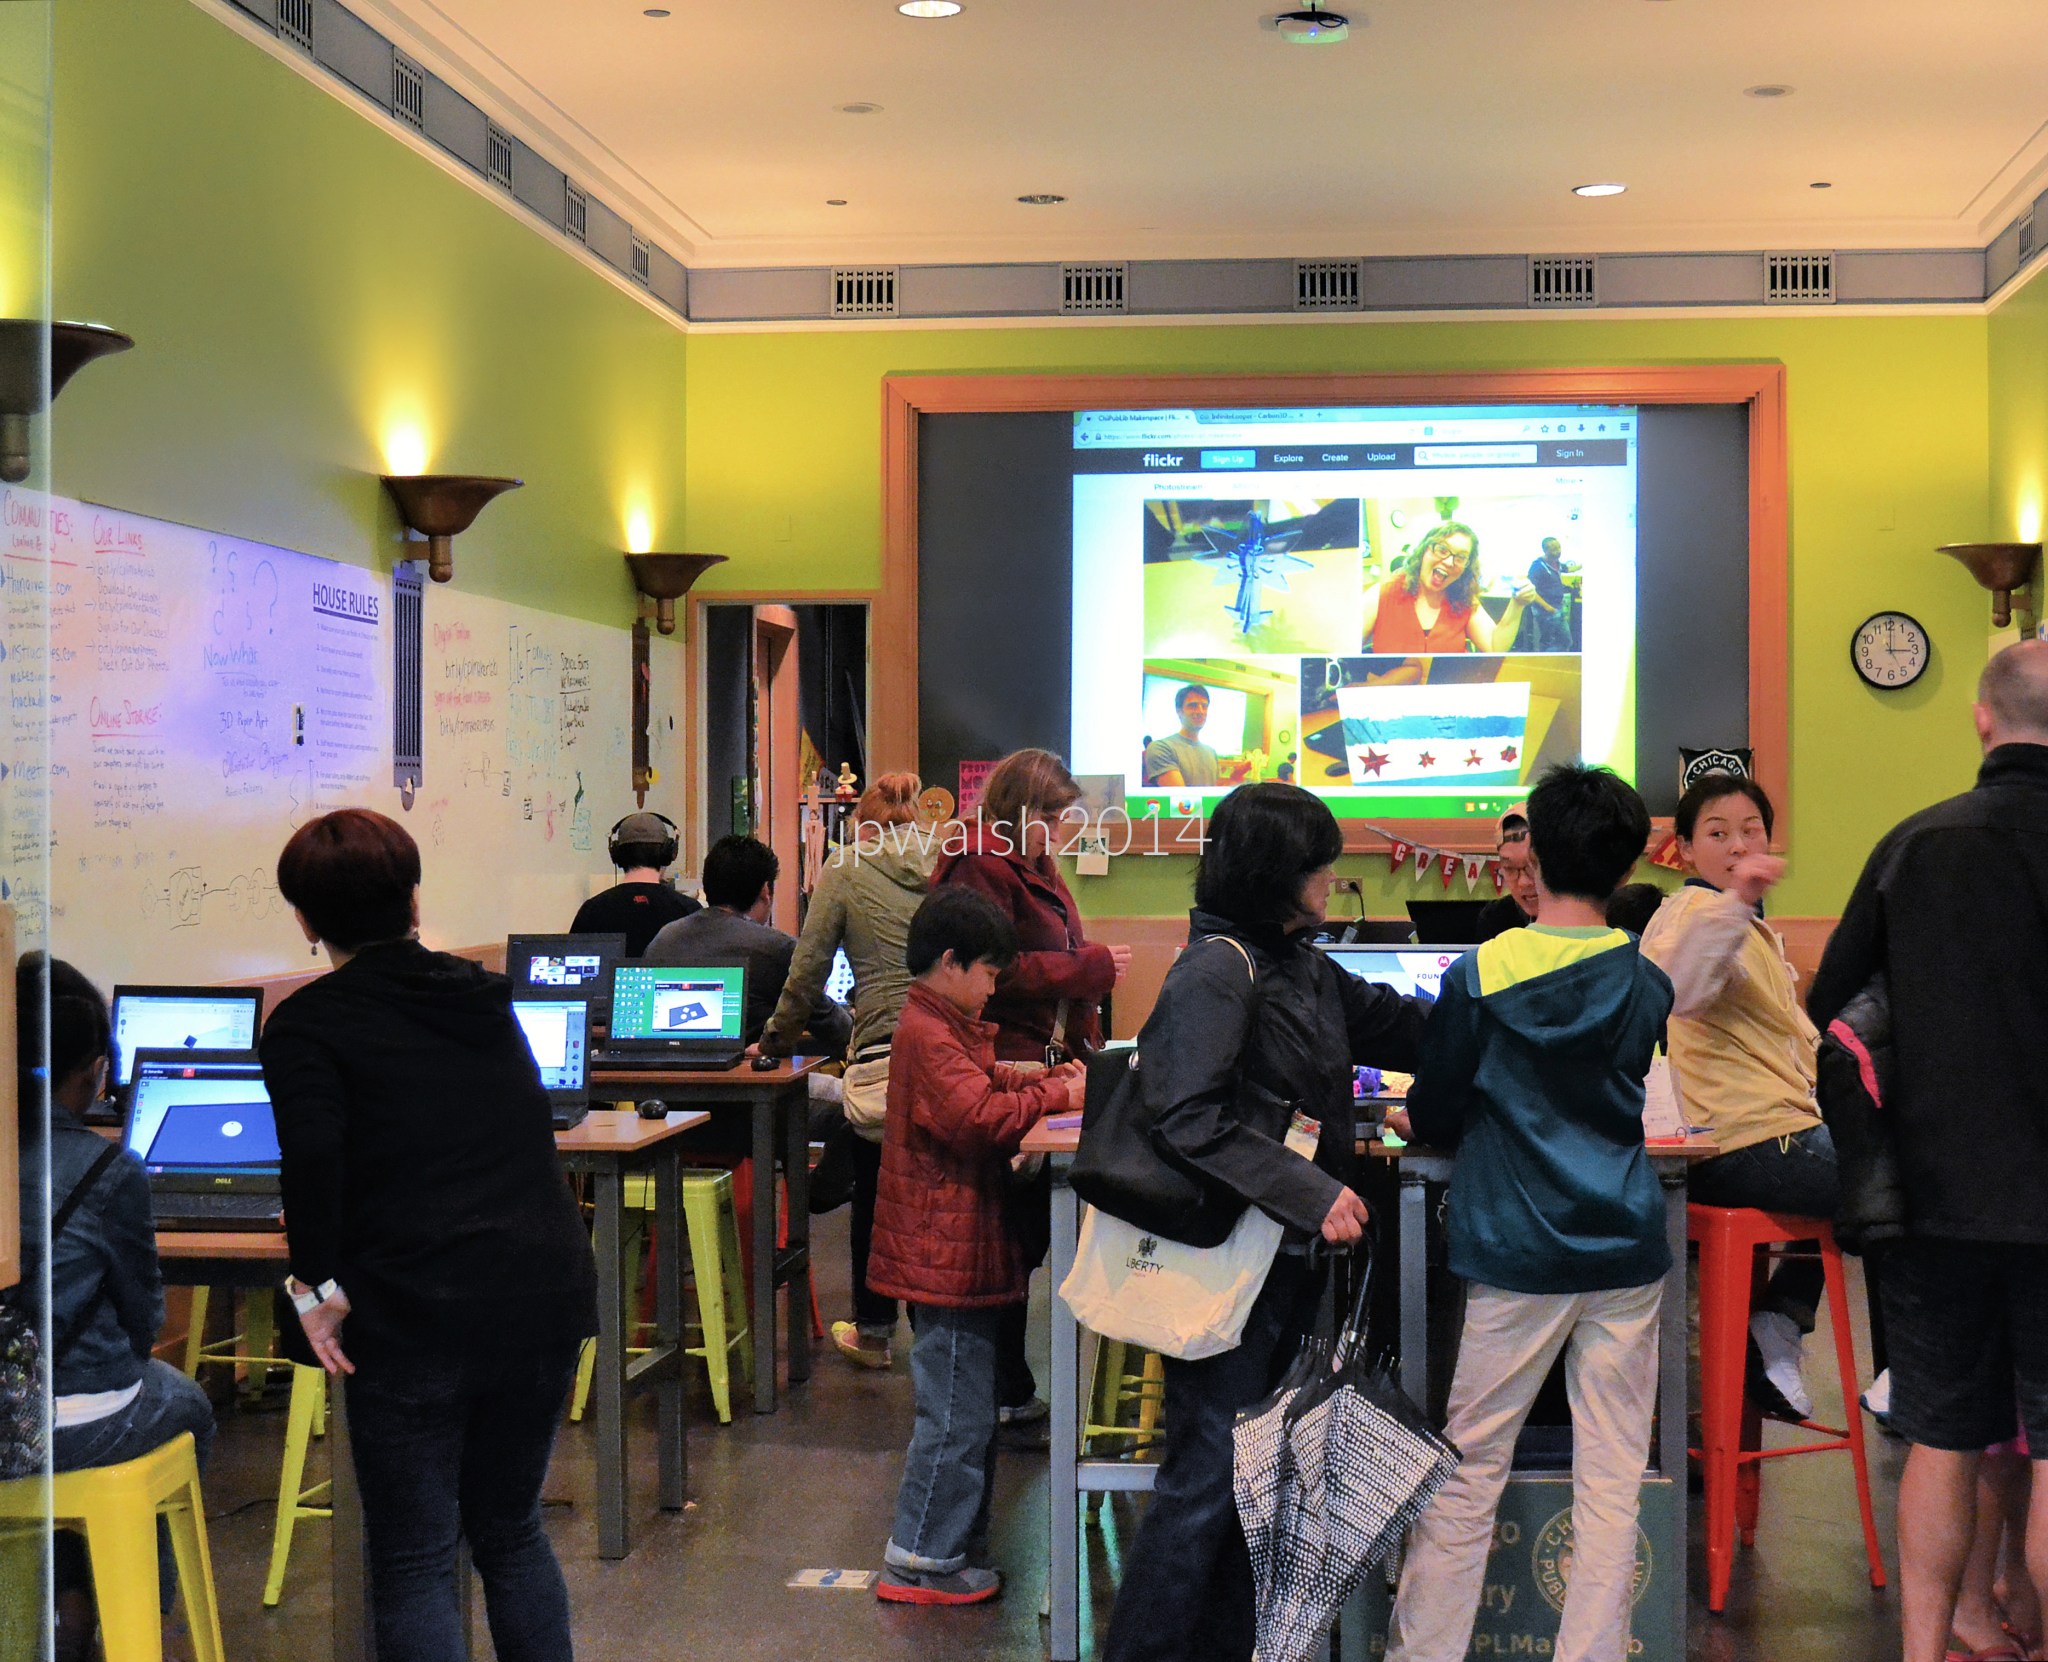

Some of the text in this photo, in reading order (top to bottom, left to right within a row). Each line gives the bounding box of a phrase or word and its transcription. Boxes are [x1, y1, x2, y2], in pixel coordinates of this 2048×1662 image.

[1212, 454, 1245, 465] Sign Up
[1273, 452, 1396, 464] Explore Create Upload
[1555, 449, 1584, 459] Sign In
[1142, 453, 1184, 467] flickr
[312, 582, 380, 619] HOUSE RULES
[1873, 625, 1882, 635] 11
[1883, 620, 1895, 631] 12
[1900, 623, 1904, 634] 1
[1862, 634, 1874, 645] 10
[1907, 631, 1915, 643] 2
[1861, 646, 1869, 657] 9
[1911, 644, 1919, 655] 3
[1865, 659, 1873, 670] 8
[1908, 657, 1916, 667] 4
[1875, 667, 1882, 678] 7
[1887, 669, 1895, 681] 6
[1900, 666, 1908, 677] 5
[1692, 755, 1742, 776] CHICAGO
